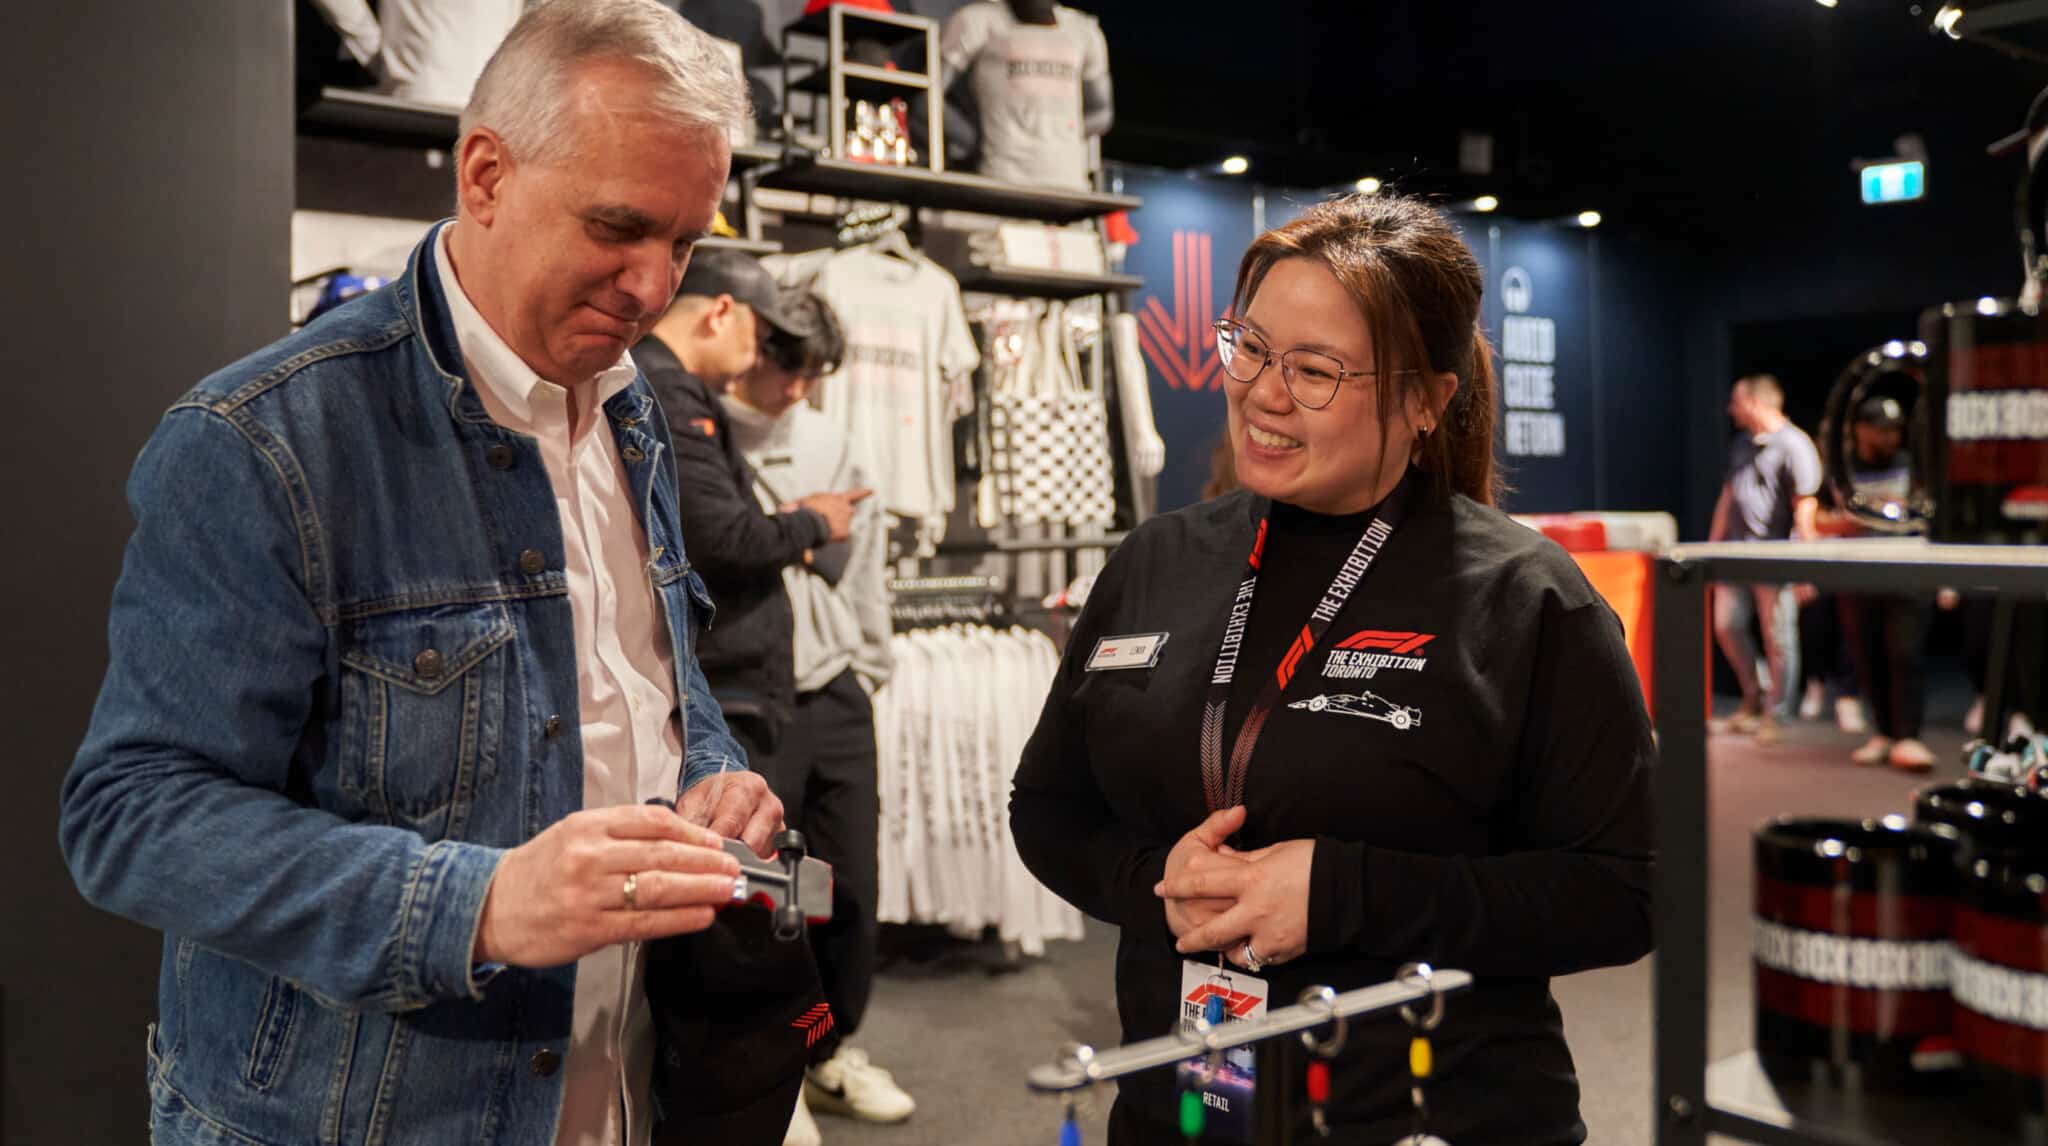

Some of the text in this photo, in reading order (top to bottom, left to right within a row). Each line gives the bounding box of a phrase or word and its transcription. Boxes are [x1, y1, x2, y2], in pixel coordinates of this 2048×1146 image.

[1311, 517, 1393, 622] THE EXHIBITION
[1211, 576, 1257, 684] THE EXHIBITION
[1321, 663, 1378, 679] TORONTO
[1327, 650, 1427, 672] THE EXHIBITION
[1203, 1092, 1230, 1112] RETAIL
